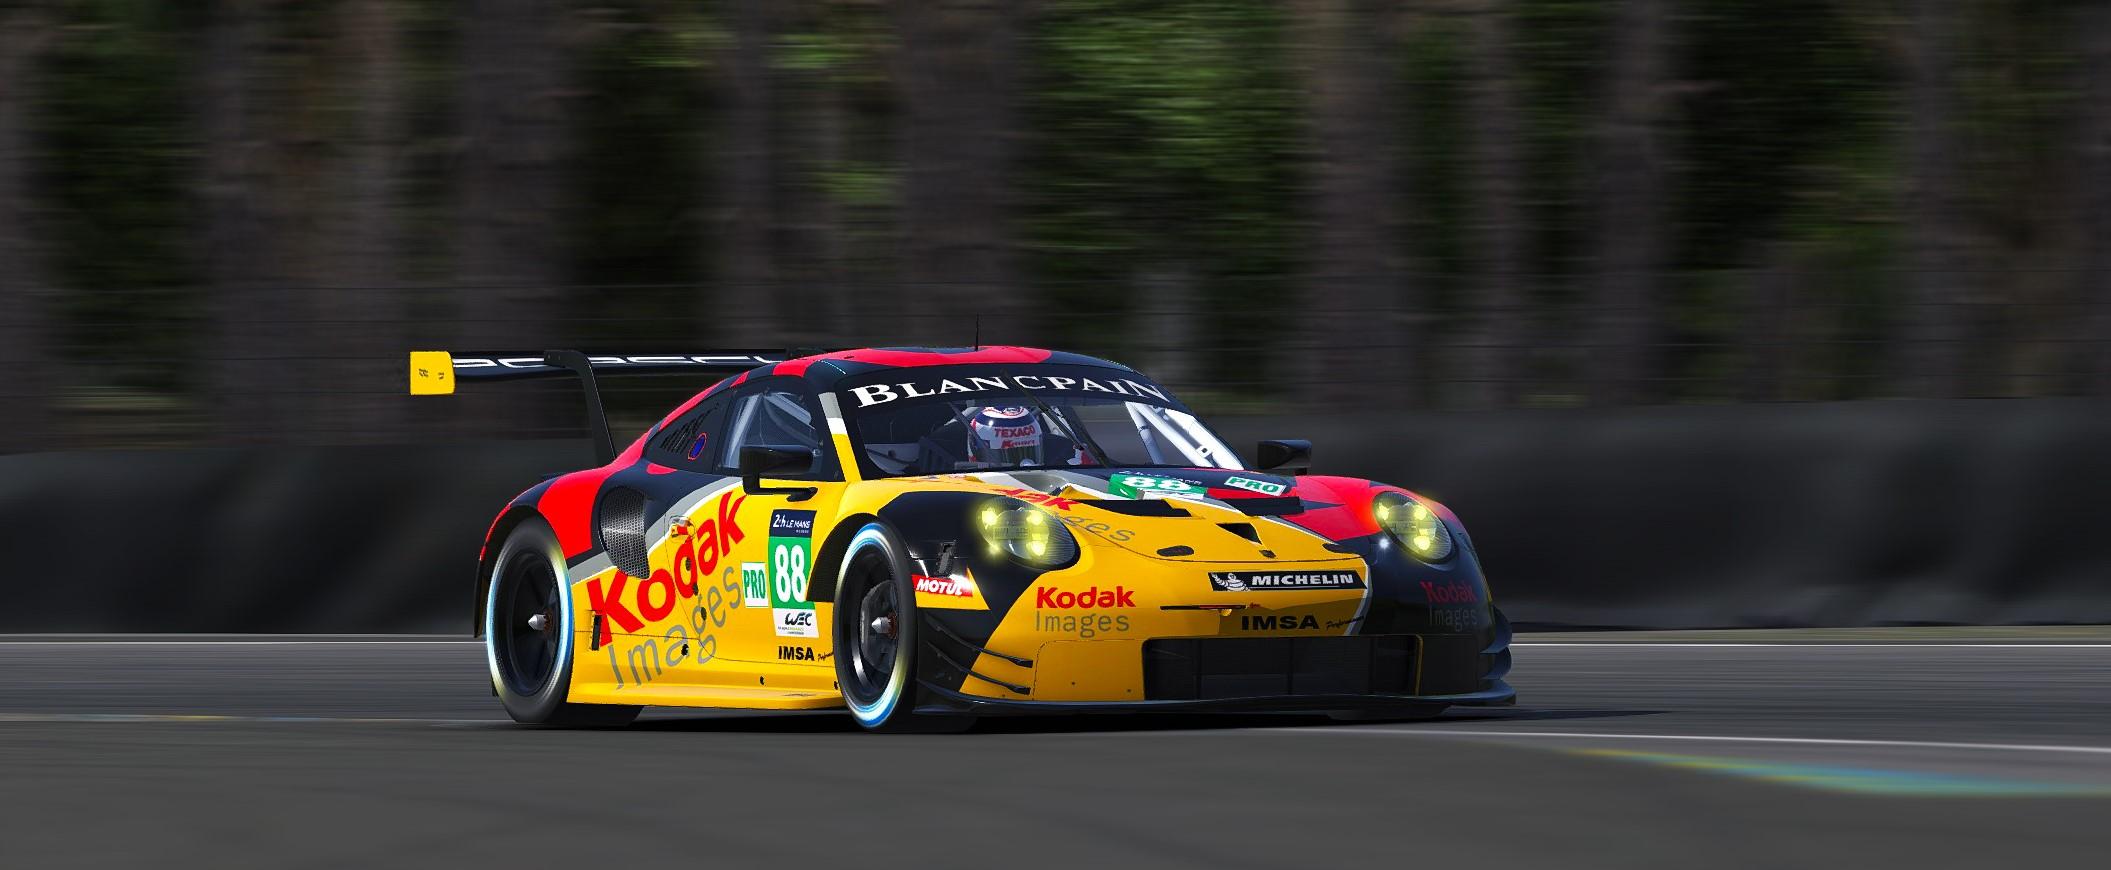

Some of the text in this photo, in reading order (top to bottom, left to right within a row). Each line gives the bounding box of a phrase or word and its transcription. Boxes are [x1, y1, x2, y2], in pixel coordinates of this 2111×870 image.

[849, 375, 1170, 408] BLANCPAIN
[994, 425, 1036, 438] TEXACO
[1122, 476, 1191, 491] 88
[1228, 477, 1280, 493] PRO
[586, 491, 748, 648] Kodak
[775, 544, 807, 603] 88
[1251, 573, 1354, 586] MICHELIN
[743, 570, 766, 599] PRO
[916, 578, 963, 596] MOTUL
[1419, 581, 1478, 605] Kodak
[1036, 585, 1137, 609] Kodak
[607, 566, 742, 690] Images
[785, 611, 813, 626] WEC
[1035, 611, 1130, 638] Images
[1241, 614, 1320, 631] IMSA
[1429, 607, 1478, 632] Images
[778, 645, 815, 661] IMSA
